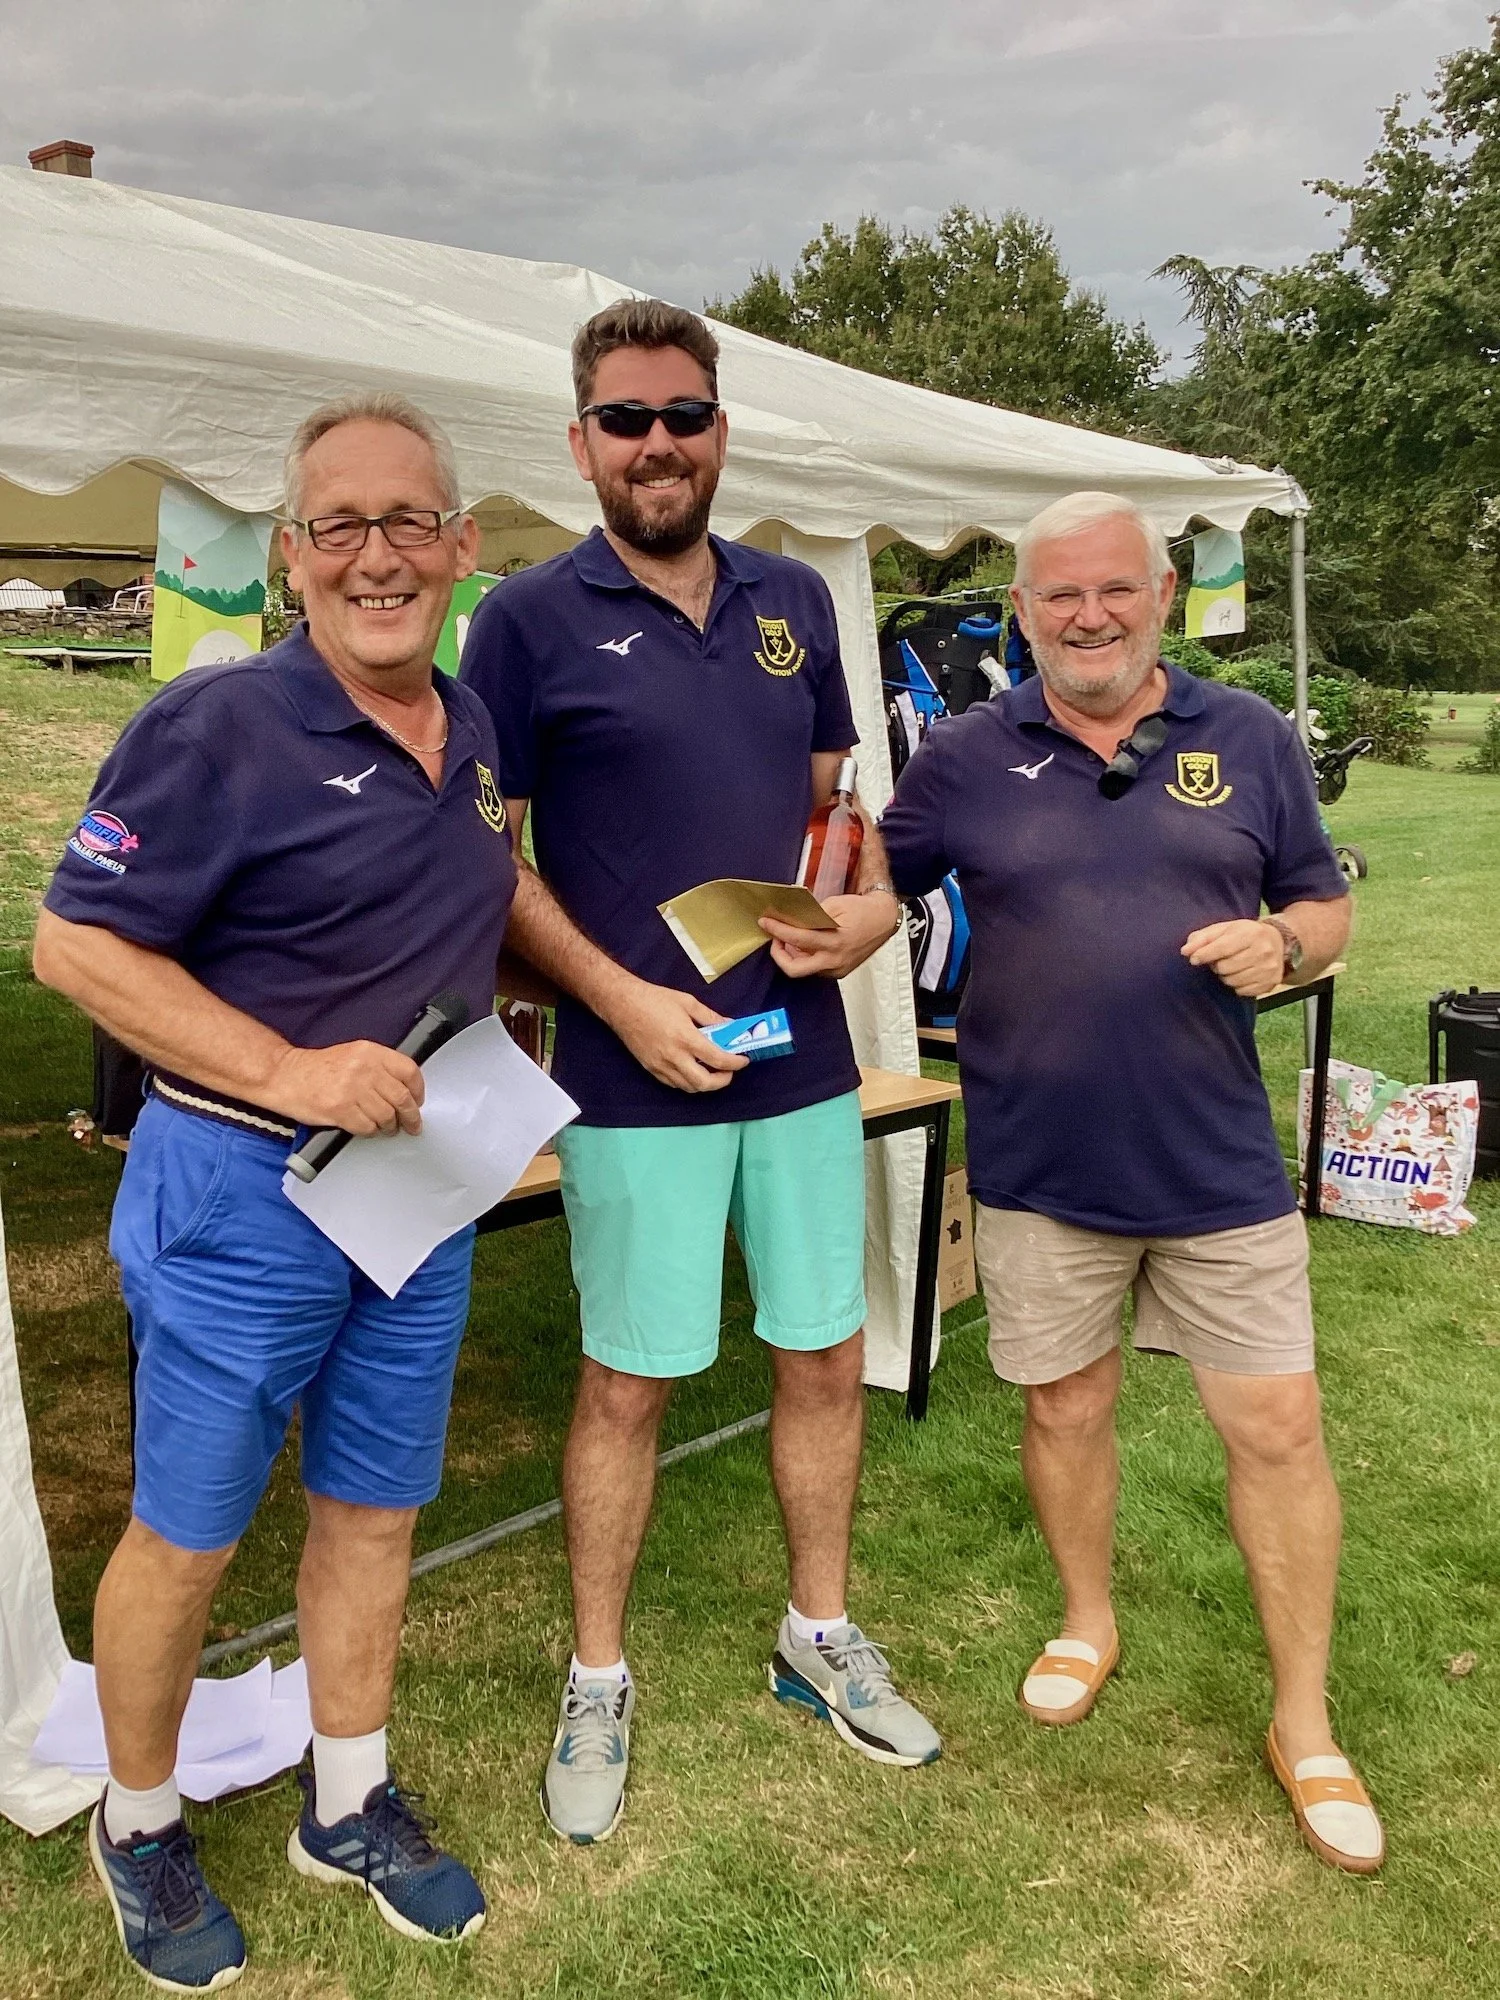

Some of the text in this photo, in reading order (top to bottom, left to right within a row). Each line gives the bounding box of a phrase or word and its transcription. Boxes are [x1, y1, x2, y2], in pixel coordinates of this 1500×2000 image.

[764, 629, 782, 637] GOLF
[94, 853, 127, 873] PNEUS
[1326, 1150, 1432, 1185] ACTION
